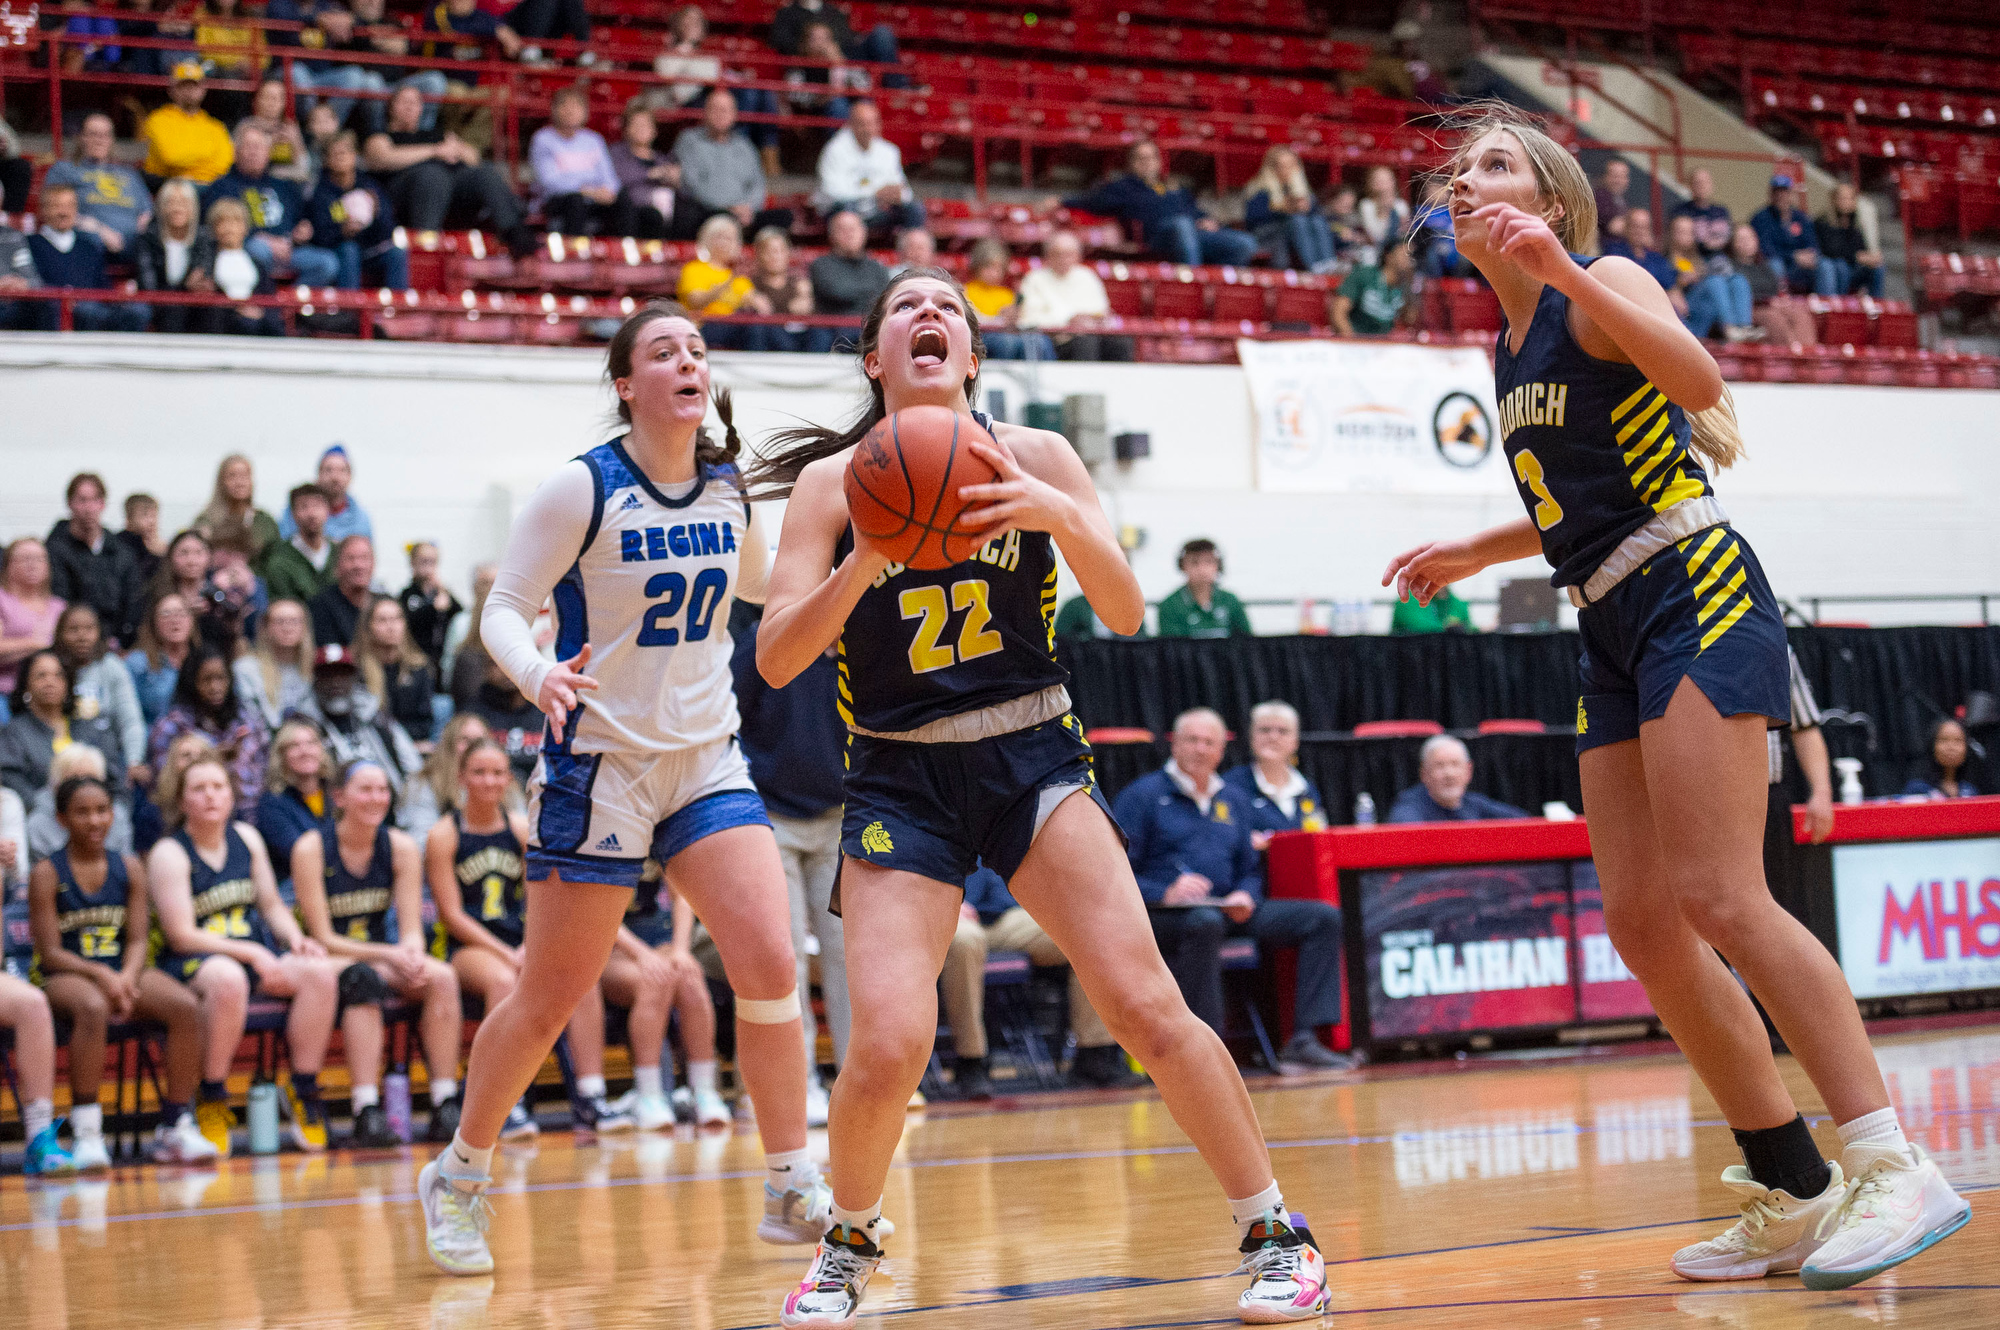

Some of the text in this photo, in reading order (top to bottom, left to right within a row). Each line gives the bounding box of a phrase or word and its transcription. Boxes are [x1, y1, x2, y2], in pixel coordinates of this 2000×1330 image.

[1500, 382, 1567, 449] ODRICH
[1514, 448, 1564, 531] 3
[621, 521, 736, 563] REGINA
[636, 567, 728, 648] 20
[898, 579, 1004, 674] 22
[1381, 933, 1638, 999] CALIHAN HA
